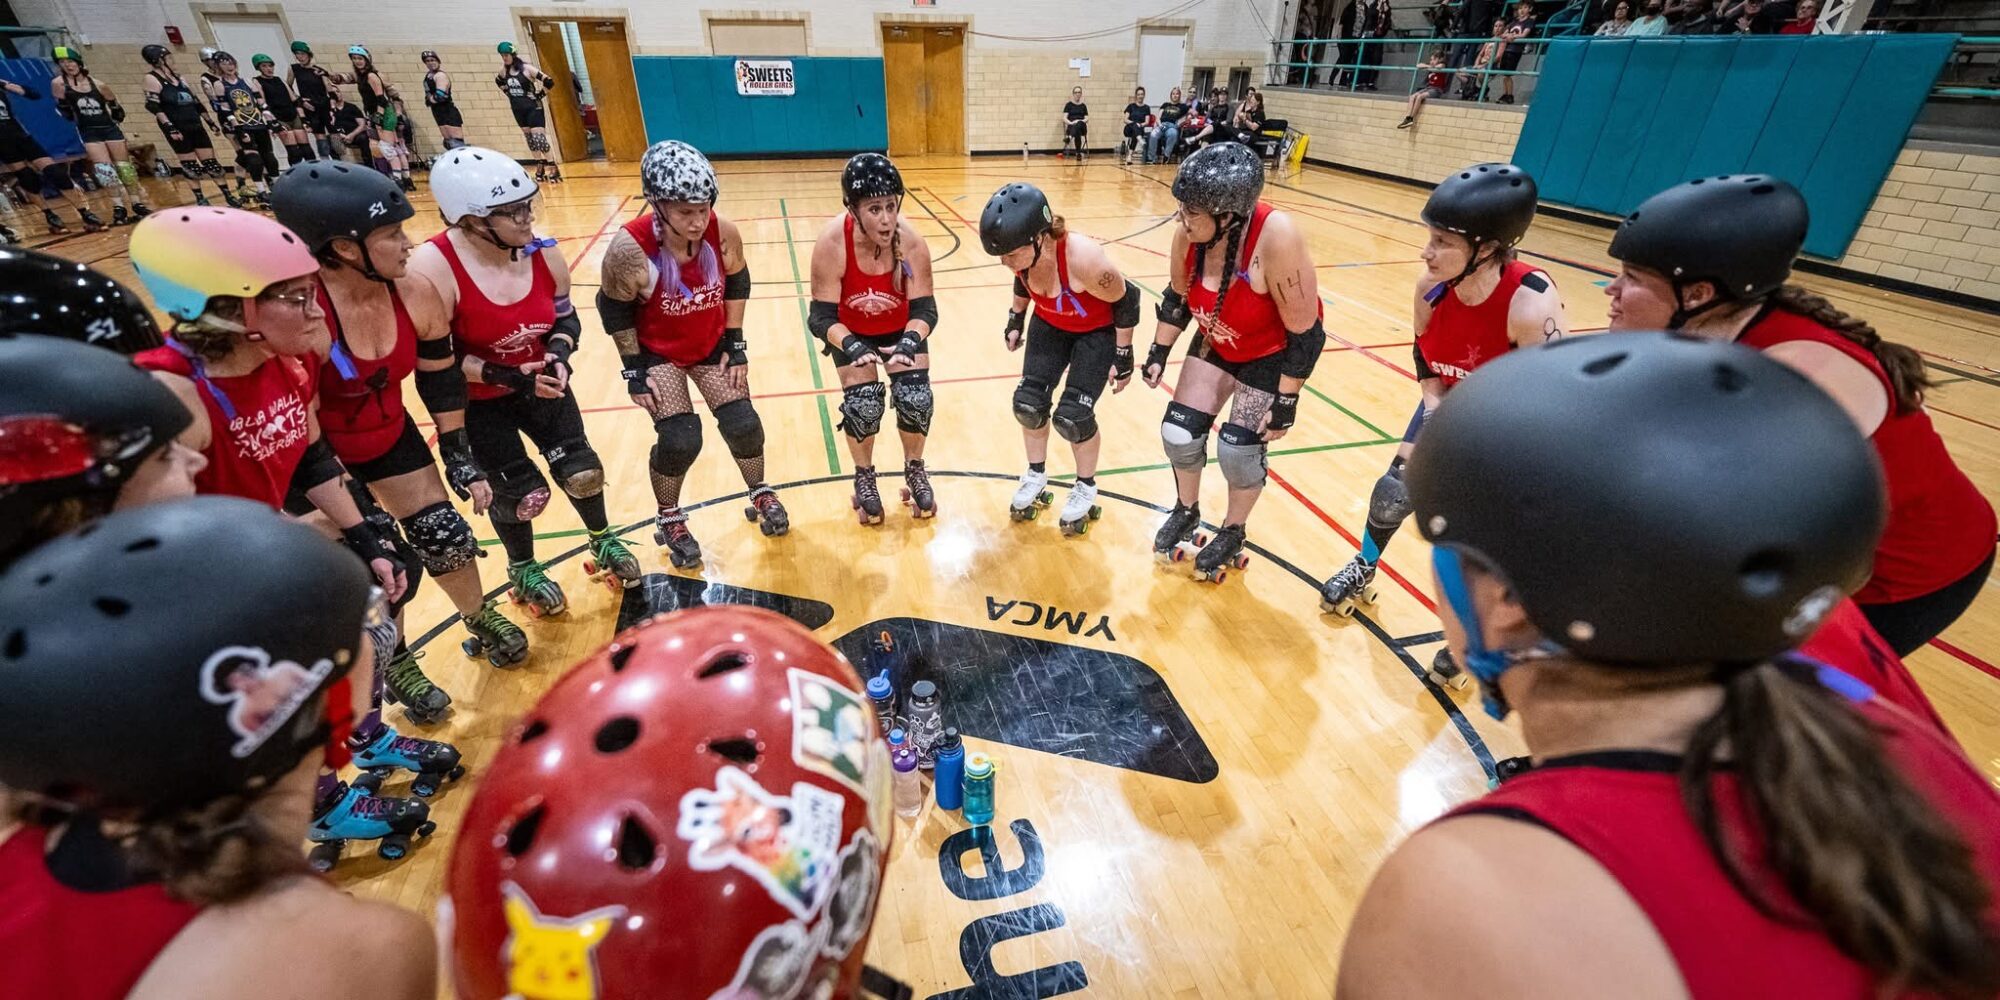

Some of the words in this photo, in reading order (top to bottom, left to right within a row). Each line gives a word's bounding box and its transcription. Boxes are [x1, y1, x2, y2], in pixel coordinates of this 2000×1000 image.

[747, 67, 793, 82] SWEETS
[749, 81, 773, 89] ROLLER
[774, 81, 793, 89] GIRLS
[490, 185, 506, 198] S1
[368, 201, 388, 218] S1
[1277, 269, 1305, 304] 14
[86, 318, 122, 342] S1
[985, 595, 1116, 641] YMCA
